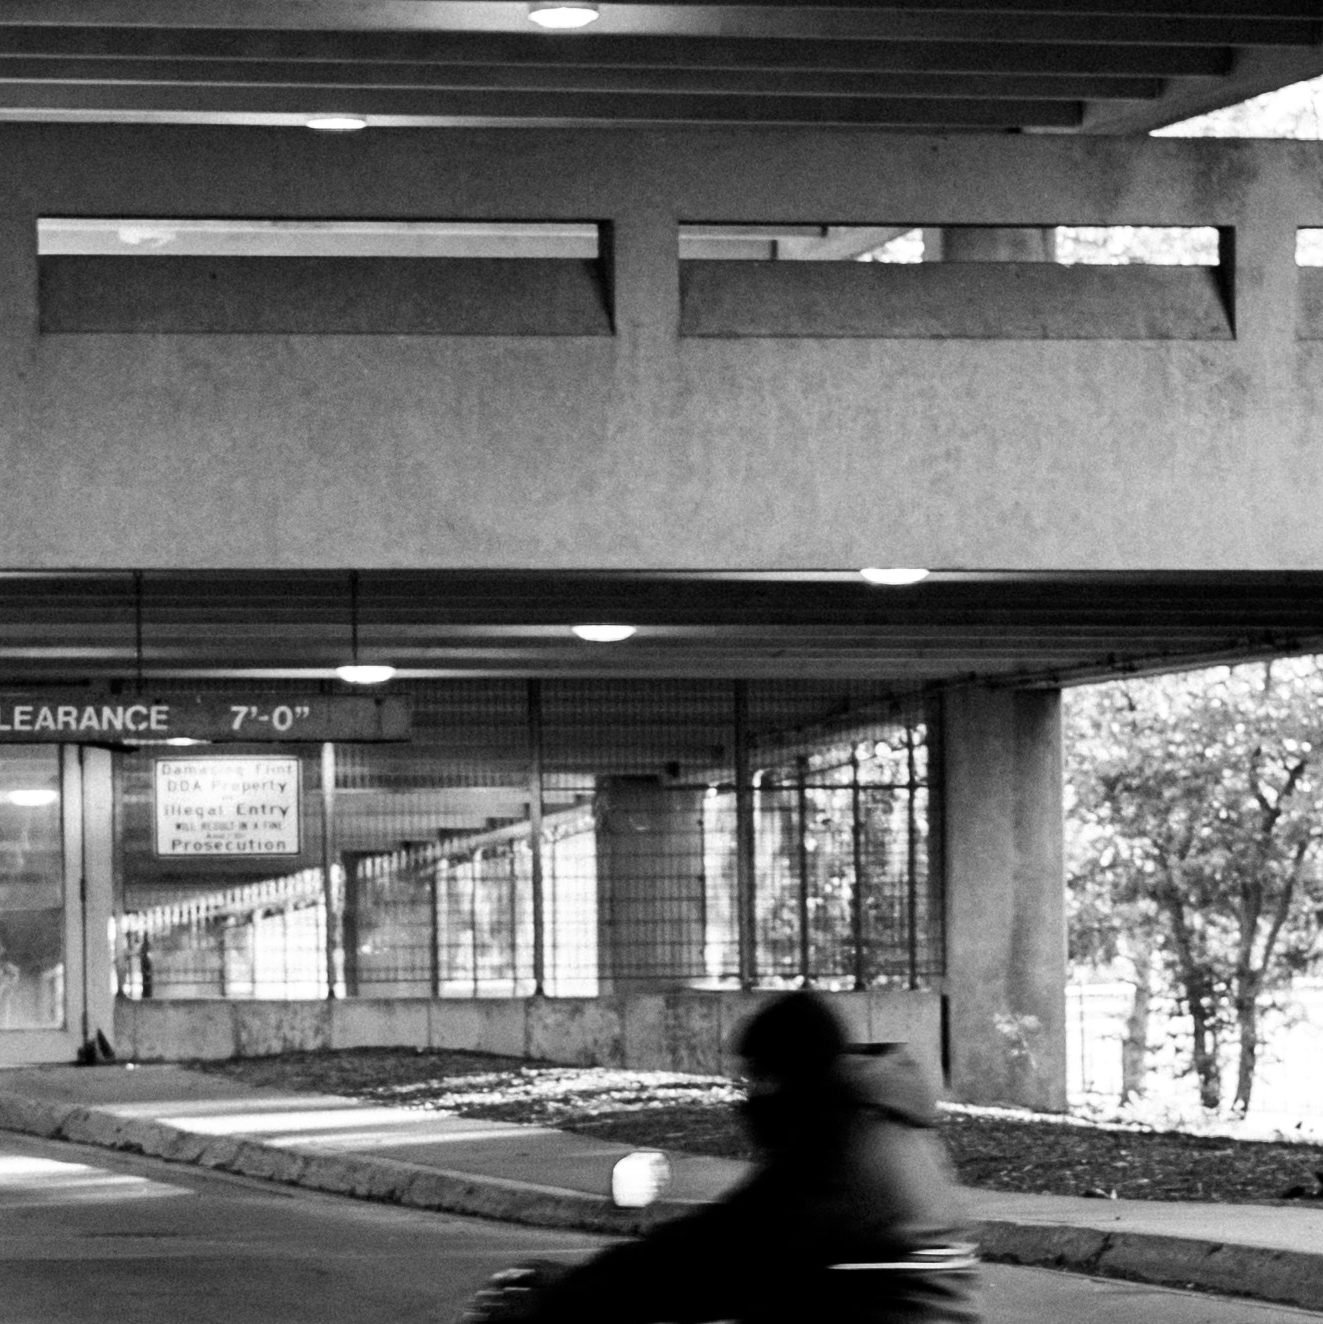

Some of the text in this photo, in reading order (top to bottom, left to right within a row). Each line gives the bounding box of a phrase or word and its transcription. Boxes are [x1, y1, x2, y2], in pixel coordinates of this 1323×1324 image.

[167, 780, 287, 793] DDA Property
[236, 803, 289, 818] Entry
[171, 839, 287, 851] Prosecution
